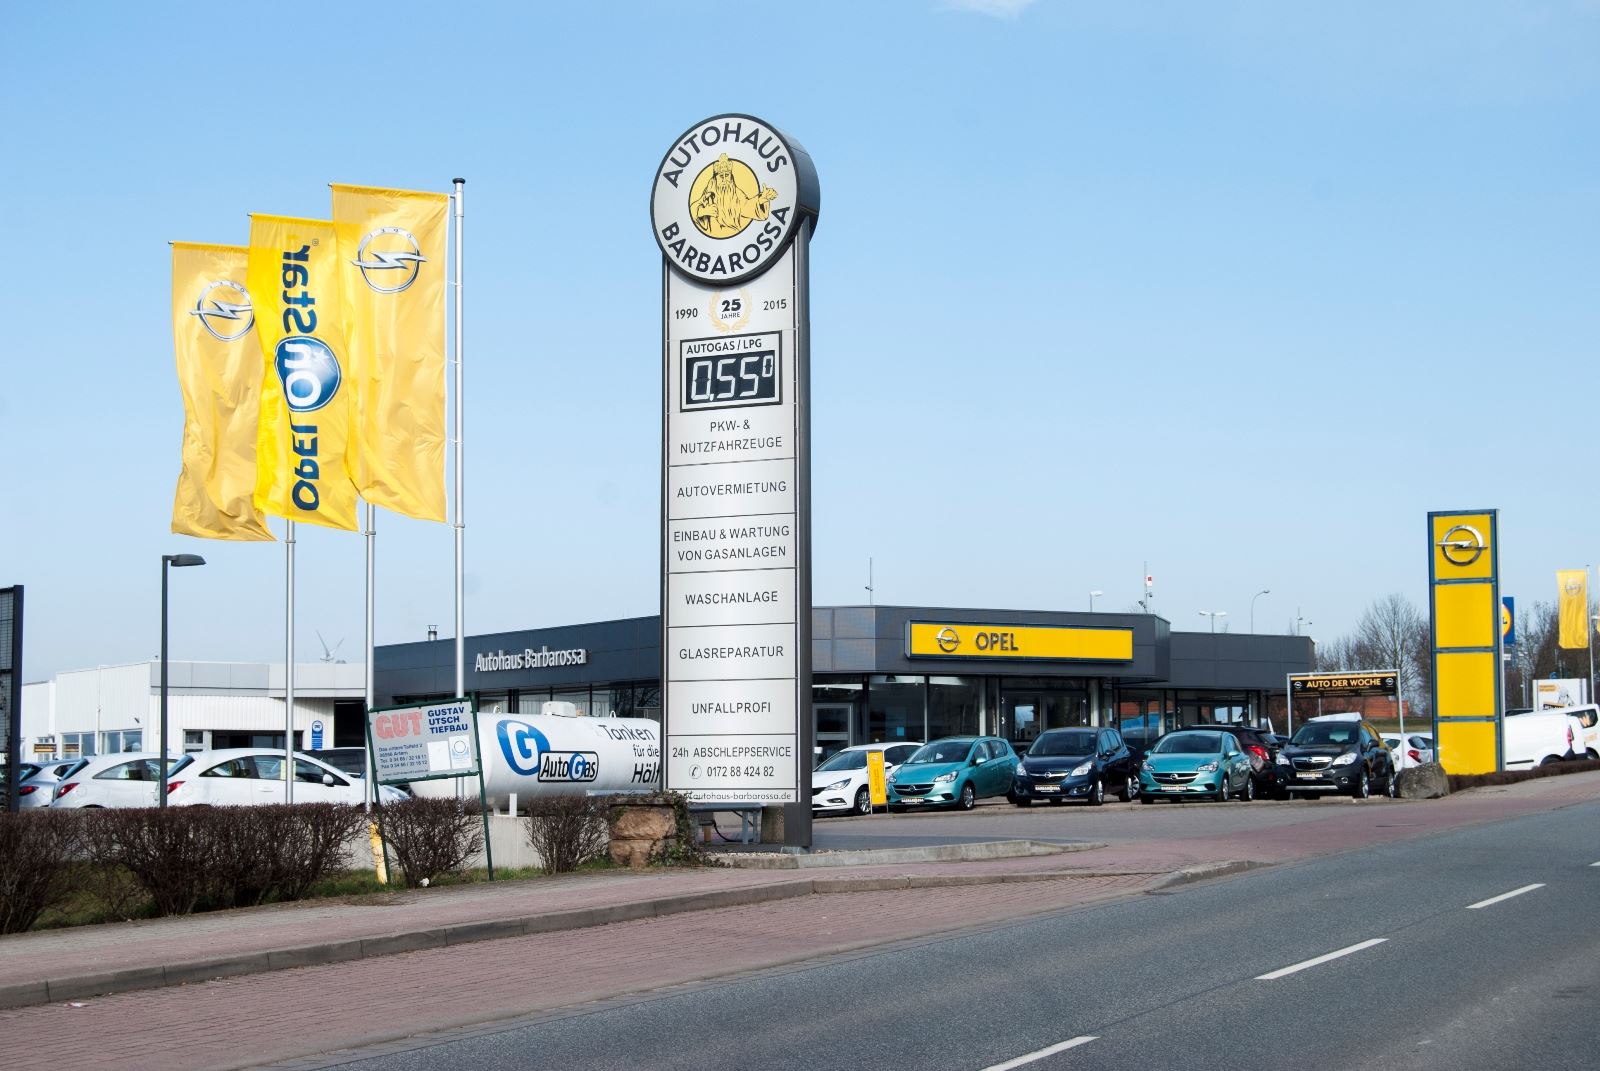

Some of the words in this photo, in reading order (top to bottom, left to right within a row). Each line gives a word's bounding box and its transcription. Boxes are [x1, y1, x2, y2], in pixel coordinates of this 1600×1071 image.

[663, 122, 788, 189] AUTOHAUS
[661, 206, 791, 274] BARBAROSSA
[675, 308, 698, 319] 1990
[763, 299, 787, 310] 2015
[721, 299, 742, 312] 25
[720, 312, 740, 320] JAHRE
[686, 340, 735, 354] AUTOGAS
[743, 338, 762, 348] LPG
[710, 421, 740, 432] PKW-
[743, 419, 750, 430] &
[680, 436, 782, 454] NUTZFAHRZEUGE
[677, 480, 787, 498] AUTOVERMIETUNG
[674, 529, 716, 542] EINBAU
[719, 529, 727, 540] &
[729, 526, 790, 539] WARTUNG
[678, 550, 702, 561] VON
[704, 546, 786, 560] GASANLAGEN
[685, 591, 778, 605] WASCHANLAGE
[975, 632, 1019, 651] OPEL
[475, 650, 524, 672] Autohaus
[524, 646, 587, 669] Barbarossa
[679, 646, 784, 660] GLASREPARATUR
[1306, 680, 1331, 688] AUTO
[1350, 678, 1382, 686] WOCHE
[428, 707, 464, 717] GUSTAV
[692, 702, 771, 714] UNFALLPROFI
[376, 712, 422, 740] GUT
[429, 716, 460, 725] UTSCH
[430, 724, 468, 734] TIEFBAU
[597, 724, 656, 740] Tanken
[632, 744, 645, 757] für
[646, 744, 660, 757] die
[672, 748, 689, 758] 24h
[693, 746, 792, 758] ABSCHLEPPSERVICE
[540, 755, 596, 779] AutoGas
[631, 762, 660, 784] Hälf
[706, 766, 728, 777] 0172
[730, 766, 741, 777] 88
[744, 766, 761, 777] 424
[763, 766, 774, 776] 82
[693, 791, 792, 800] autohaus-barbarossa.de
